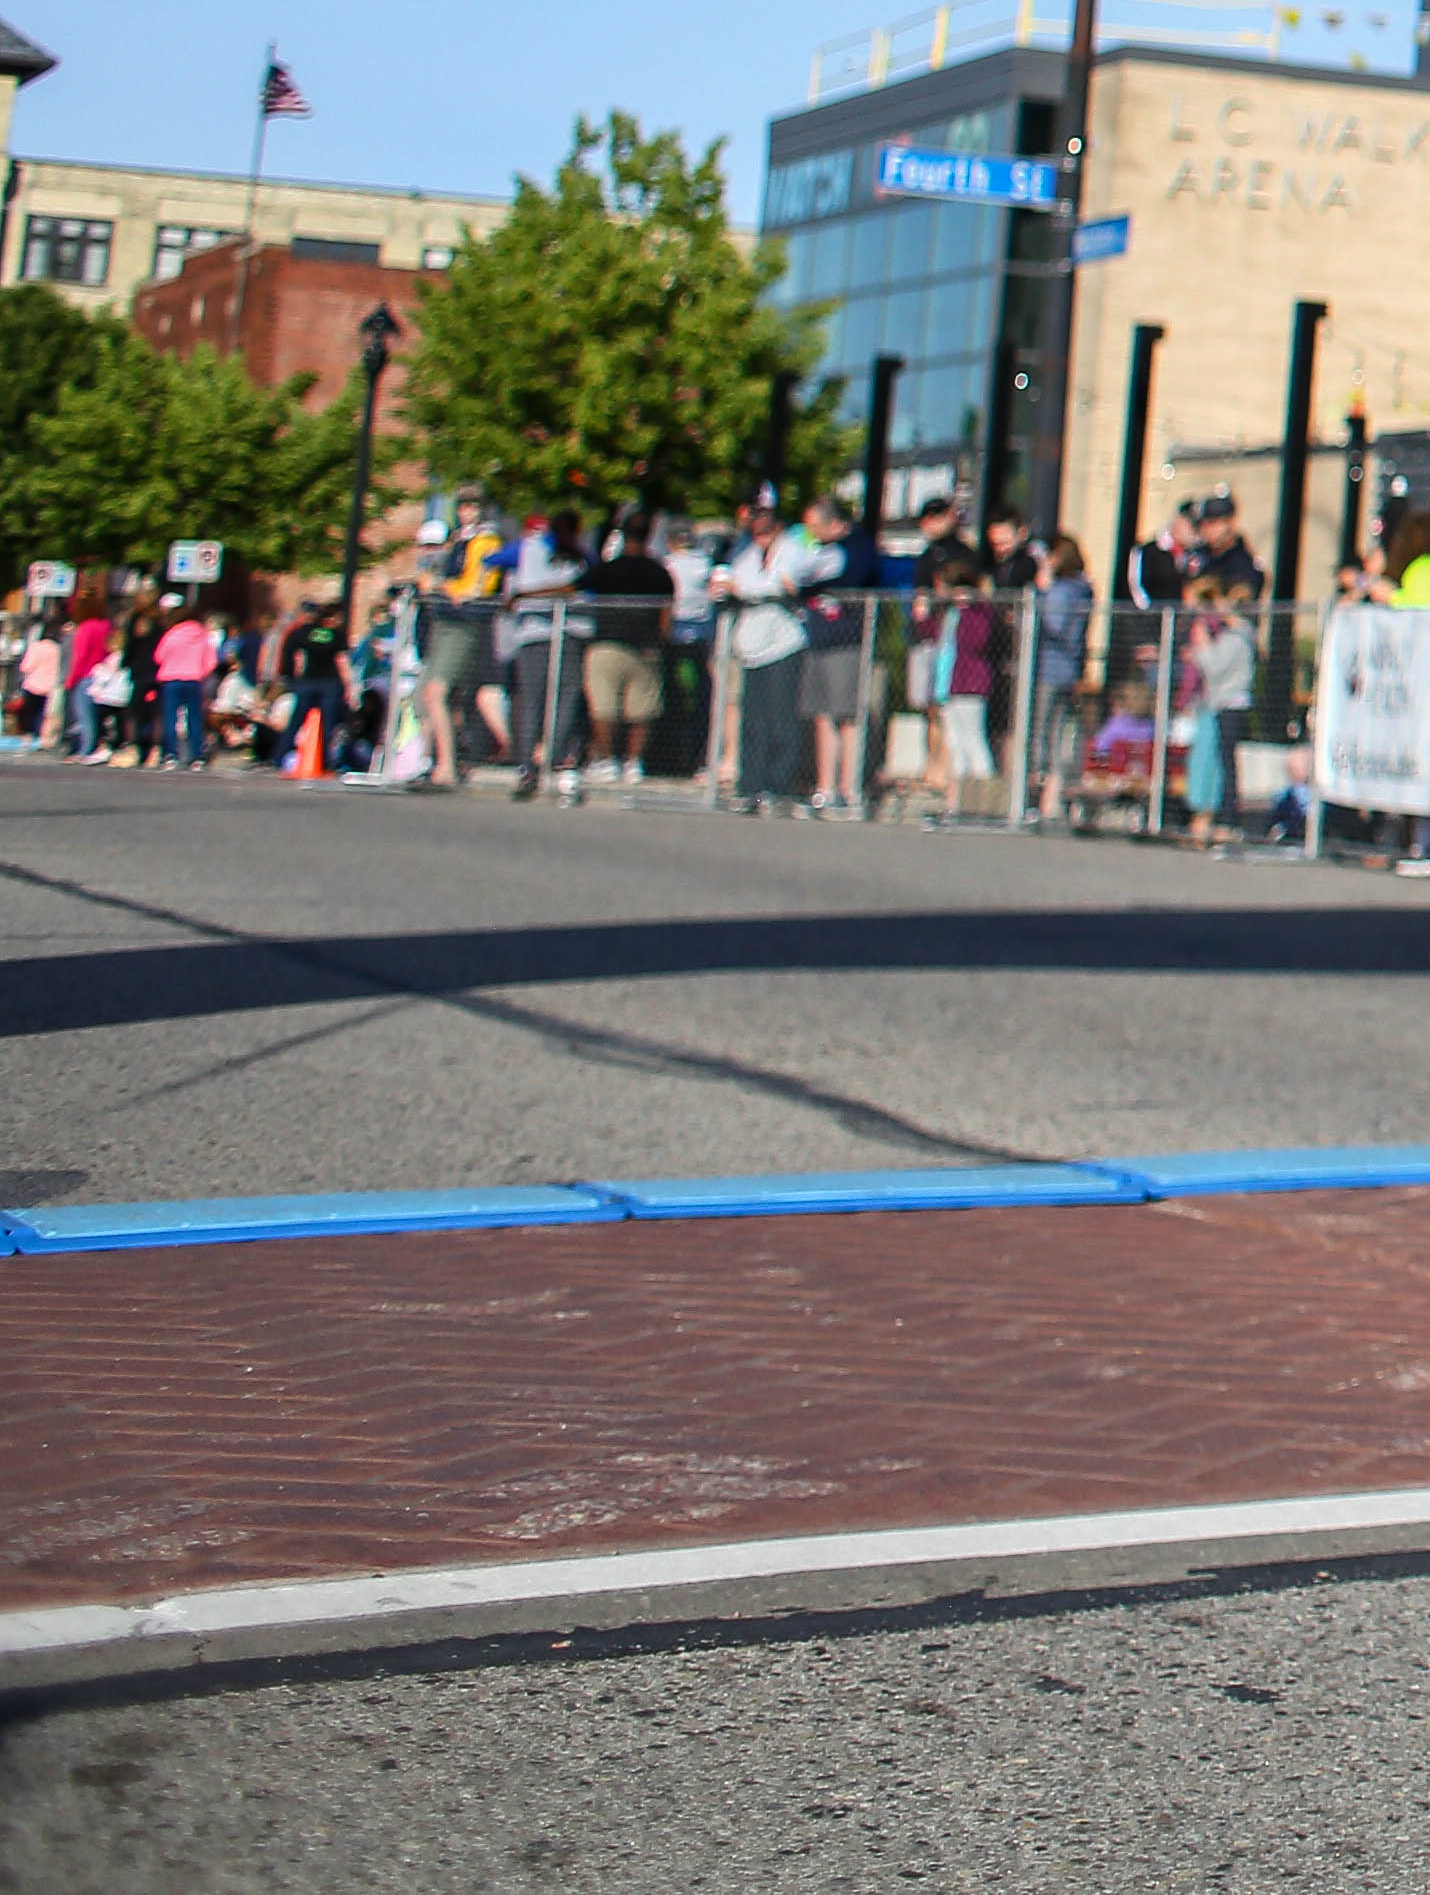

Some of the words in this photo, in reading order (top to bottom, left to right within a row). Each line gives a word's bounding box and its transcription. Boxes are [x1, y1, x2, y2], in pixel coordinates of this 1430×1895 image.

[1167, 92, 1197, 145] L
[1215, 95, 1255, 149] C
[1162, 155, 1362, 218] ARENA
